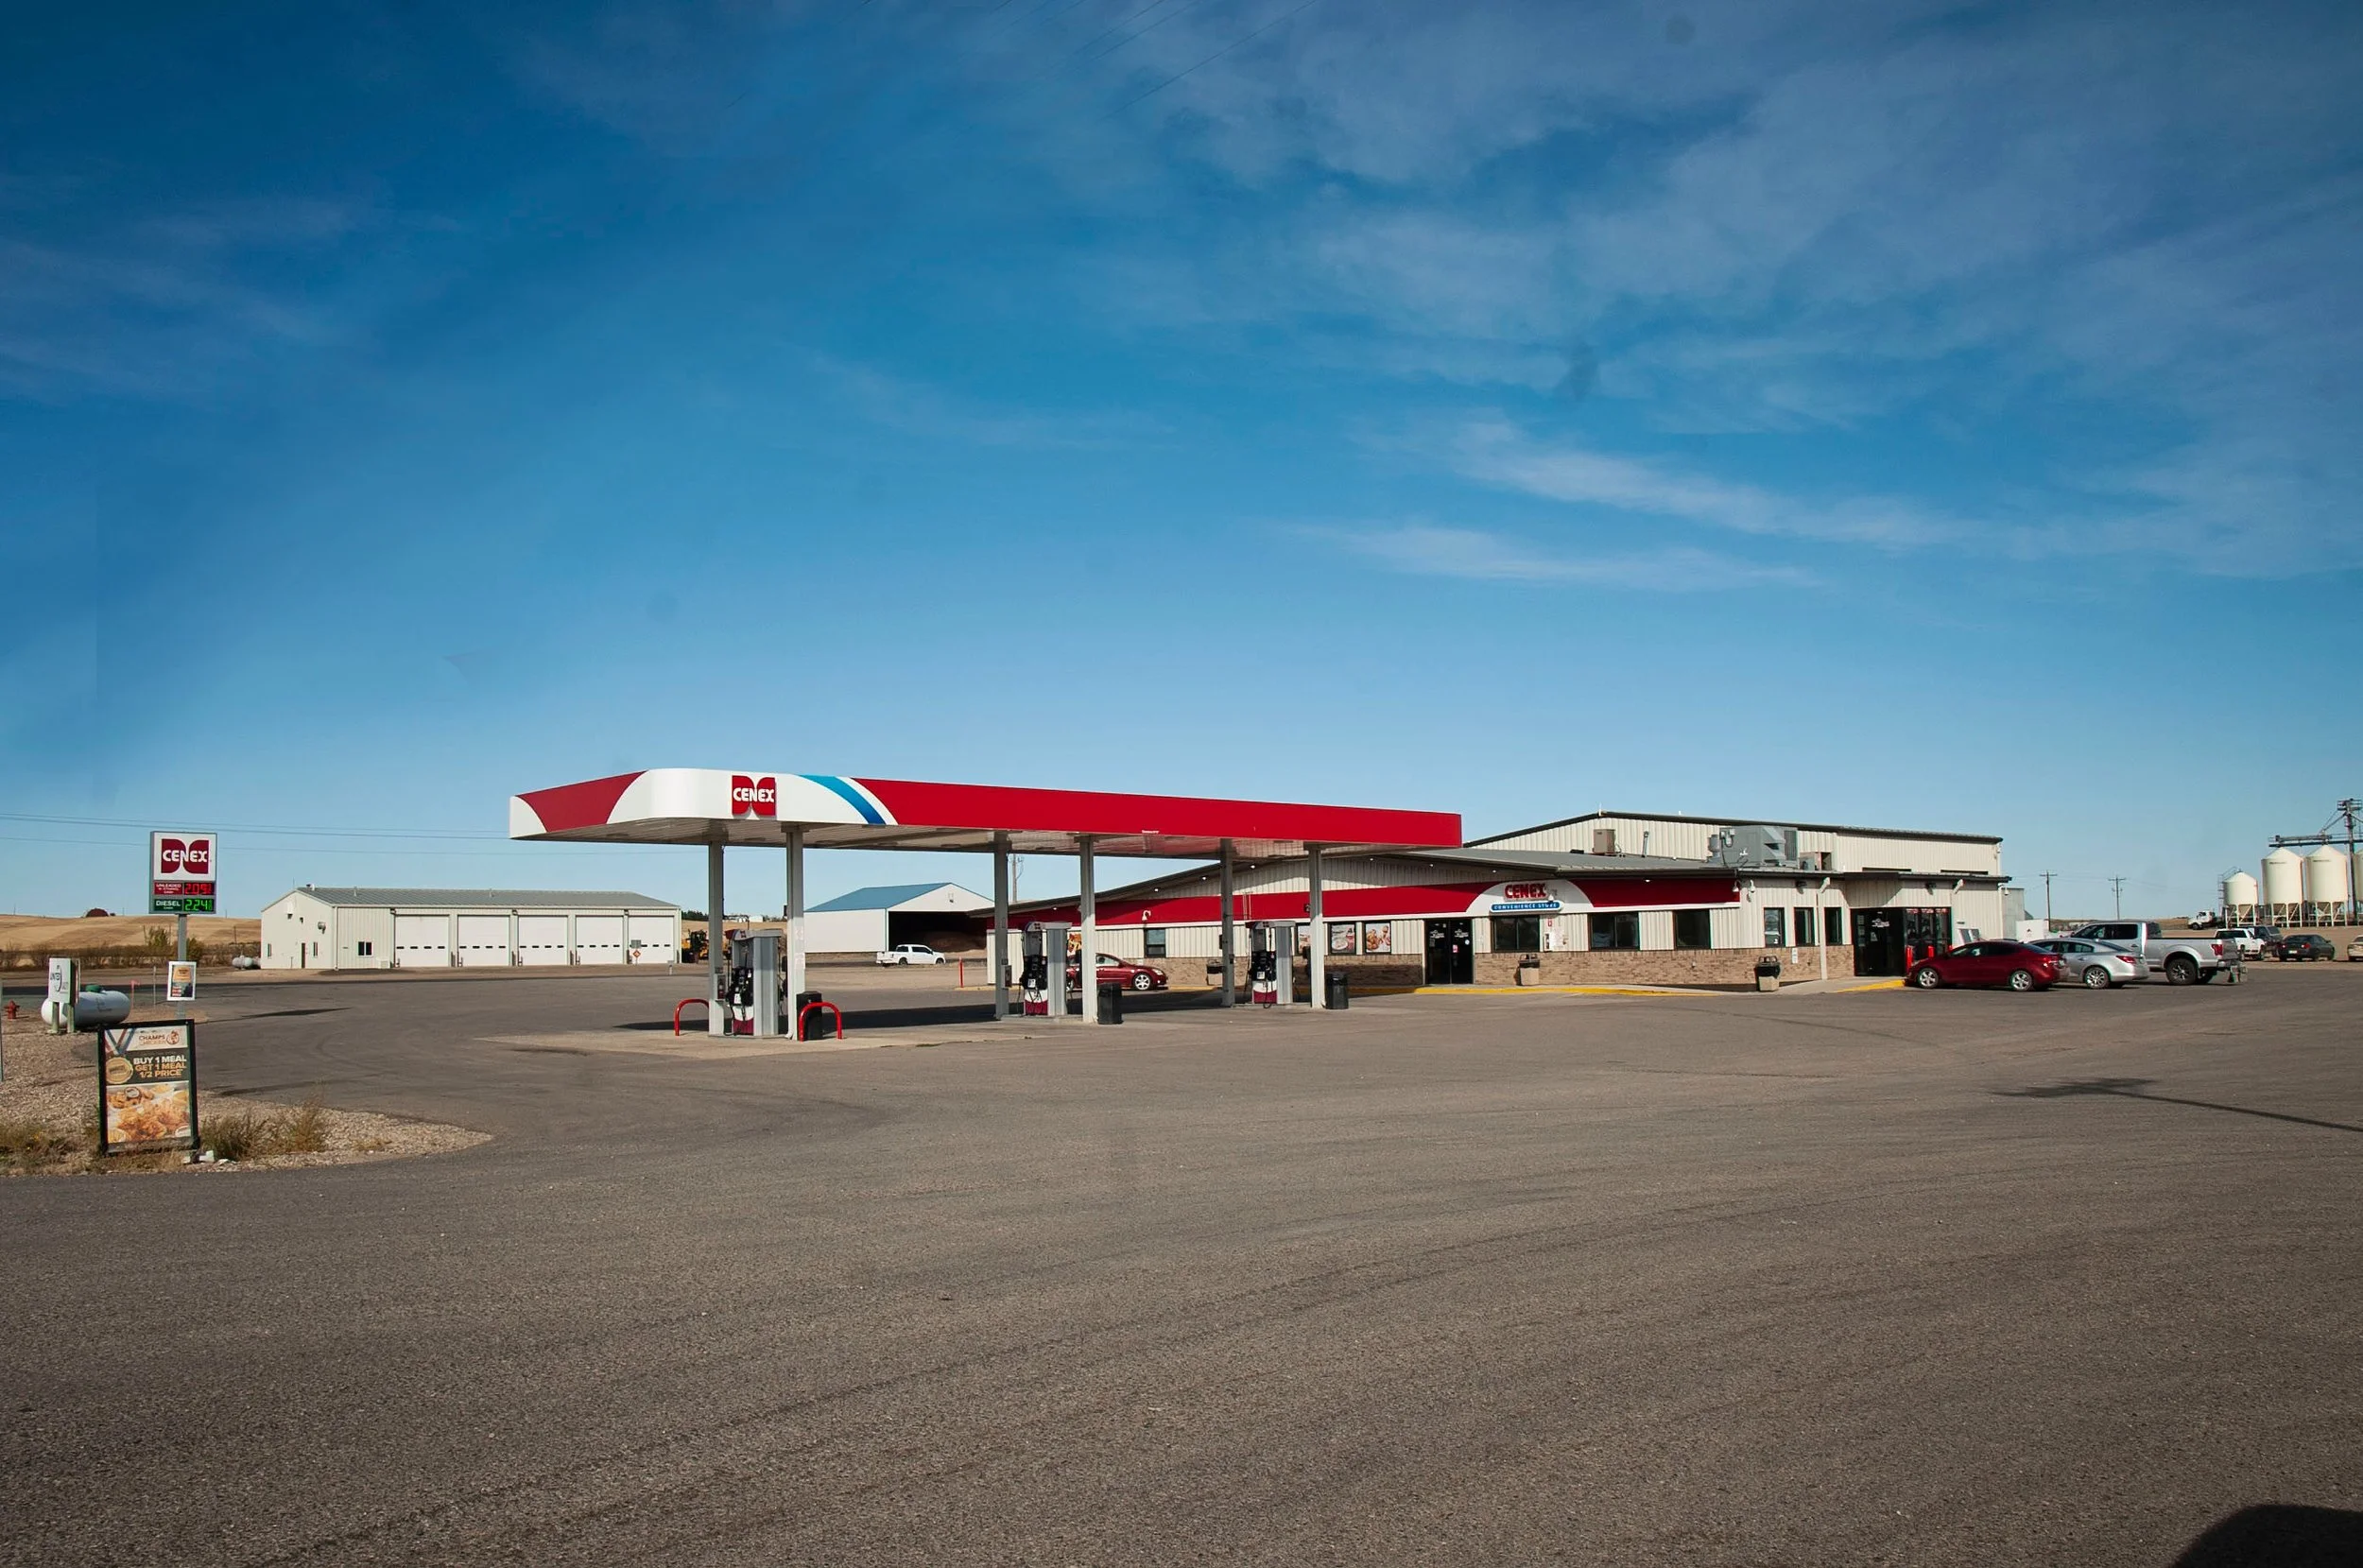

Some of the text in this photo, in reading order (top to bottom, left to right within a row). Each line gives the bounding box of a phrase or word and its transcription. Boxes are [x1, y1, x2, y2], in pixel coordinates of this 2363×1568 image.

[733, 787, 775, 802] CENEX
[162, 850, 208, 862] CENEX
[1504, 883, 1547, 899] CENEX
[133, 1057, 154, 1065] BUY
[161, 1055, 187, 1063] MEAL
[135, 1063, 153, 1072] GET
[161, 1061, 187, 1070] MEAL
